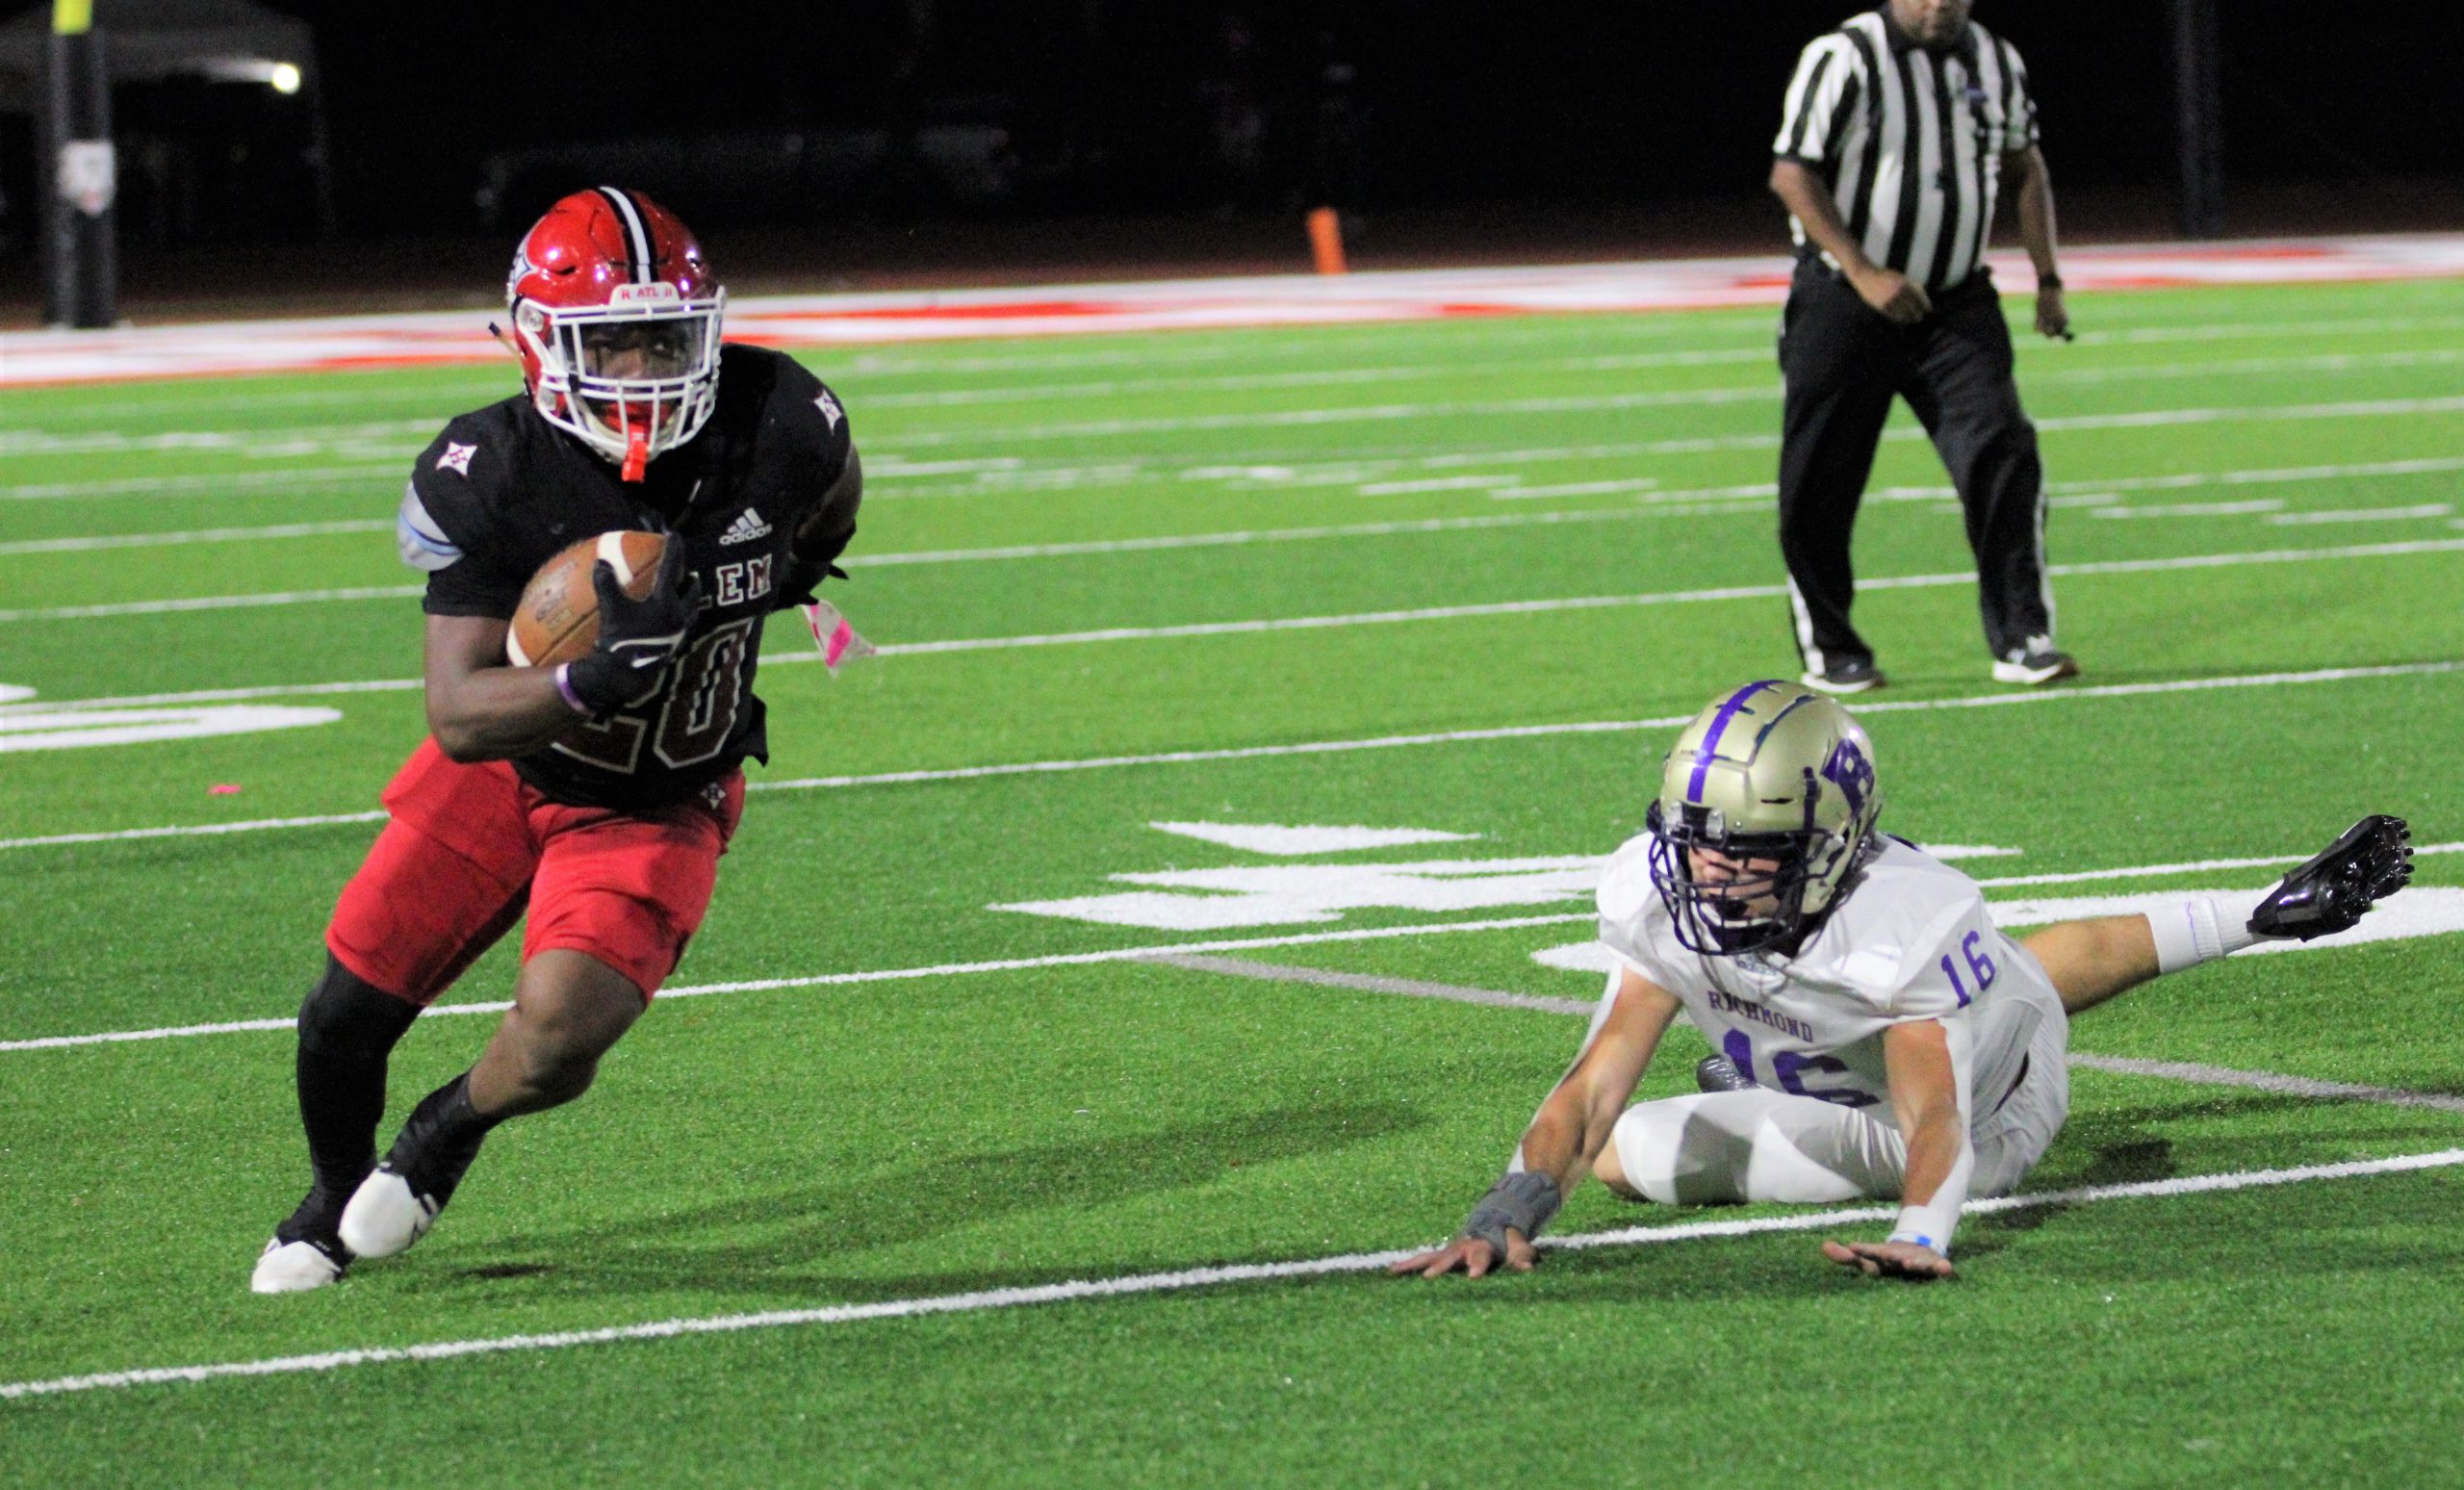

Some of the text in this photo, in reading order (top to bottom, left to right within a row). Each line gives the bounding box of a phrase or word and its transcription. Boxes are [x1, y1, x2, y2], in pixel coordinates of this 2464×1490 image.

[718, 523, 773, 546] adidas
[1940, 929, 1997, 1010] 16
[1707, 989, 1814, 1044] RICHMOND
